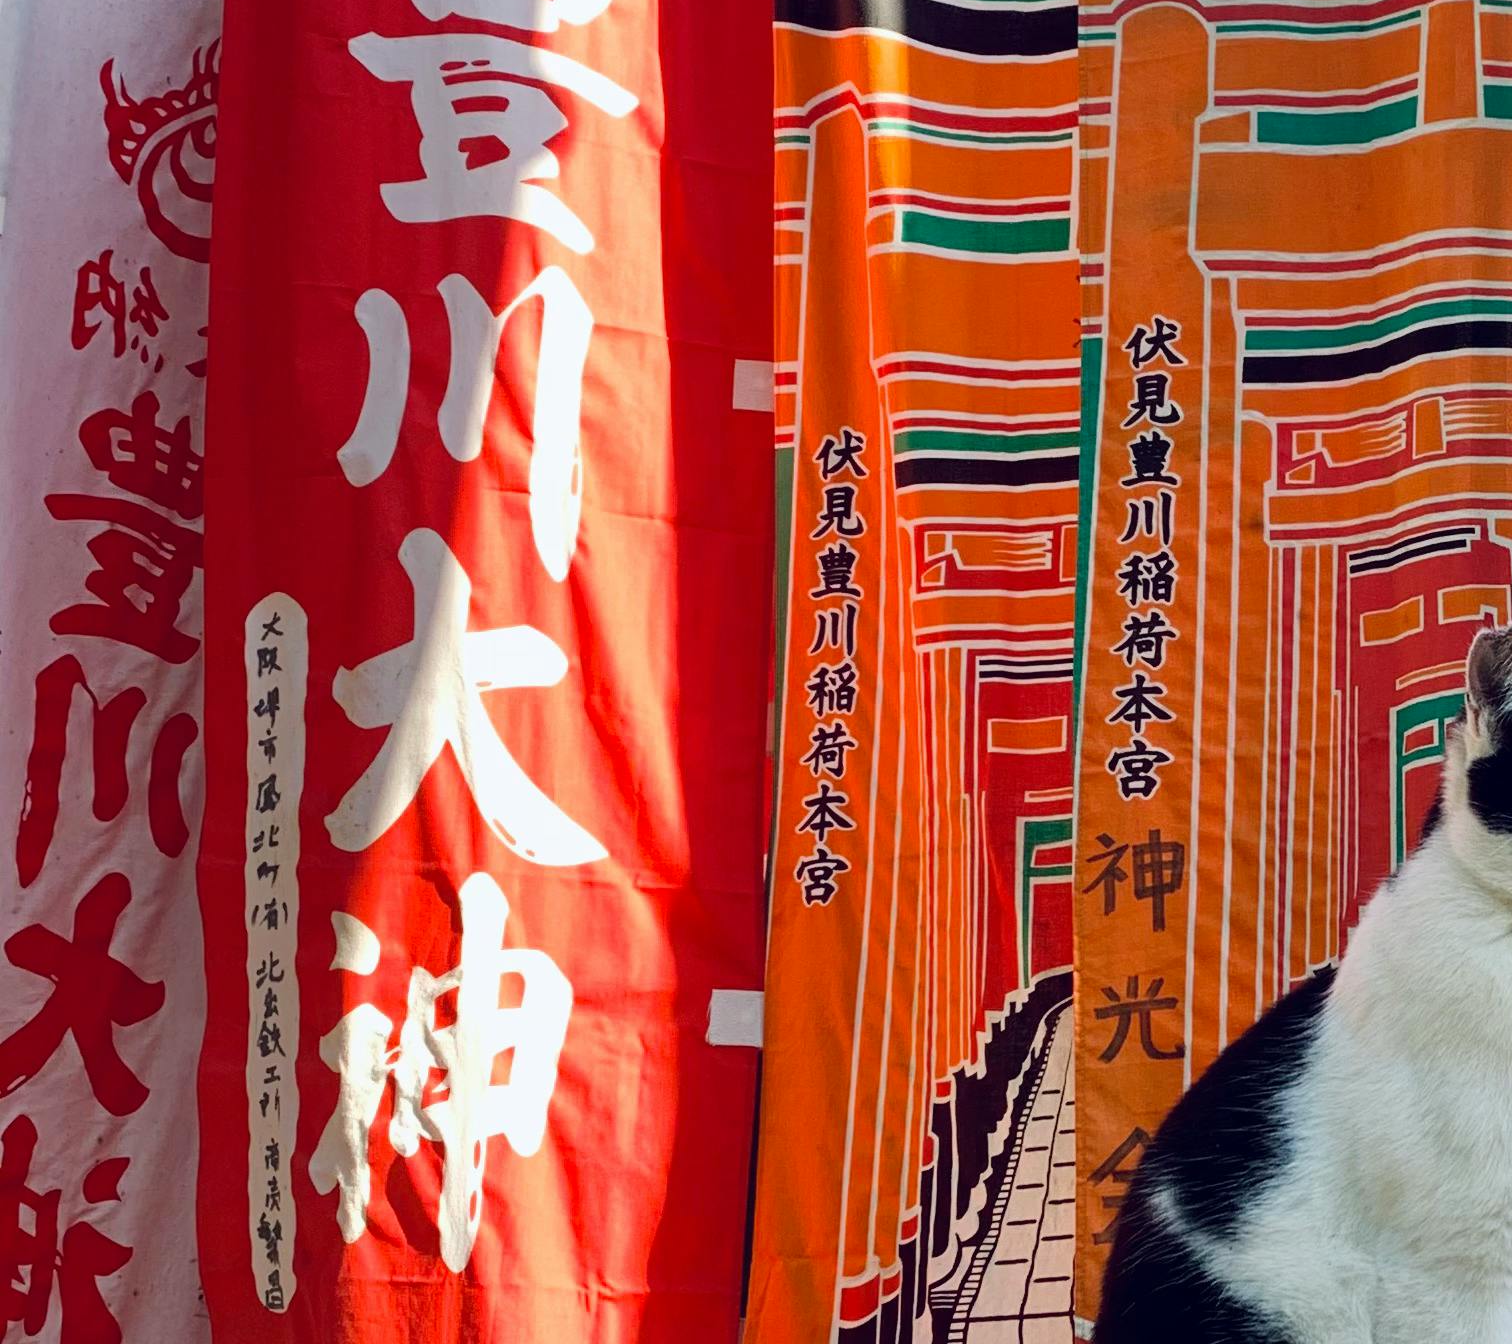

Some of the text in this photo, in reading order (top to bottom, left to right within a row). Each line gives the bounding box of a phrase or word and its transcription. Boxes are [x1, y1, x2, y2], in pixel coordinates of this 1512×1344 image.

[796, 430, 868, 907] 伏見豊川稲荷本宮
[1108, 318, 1186, 798] 伏見豊川稲荷本宮
